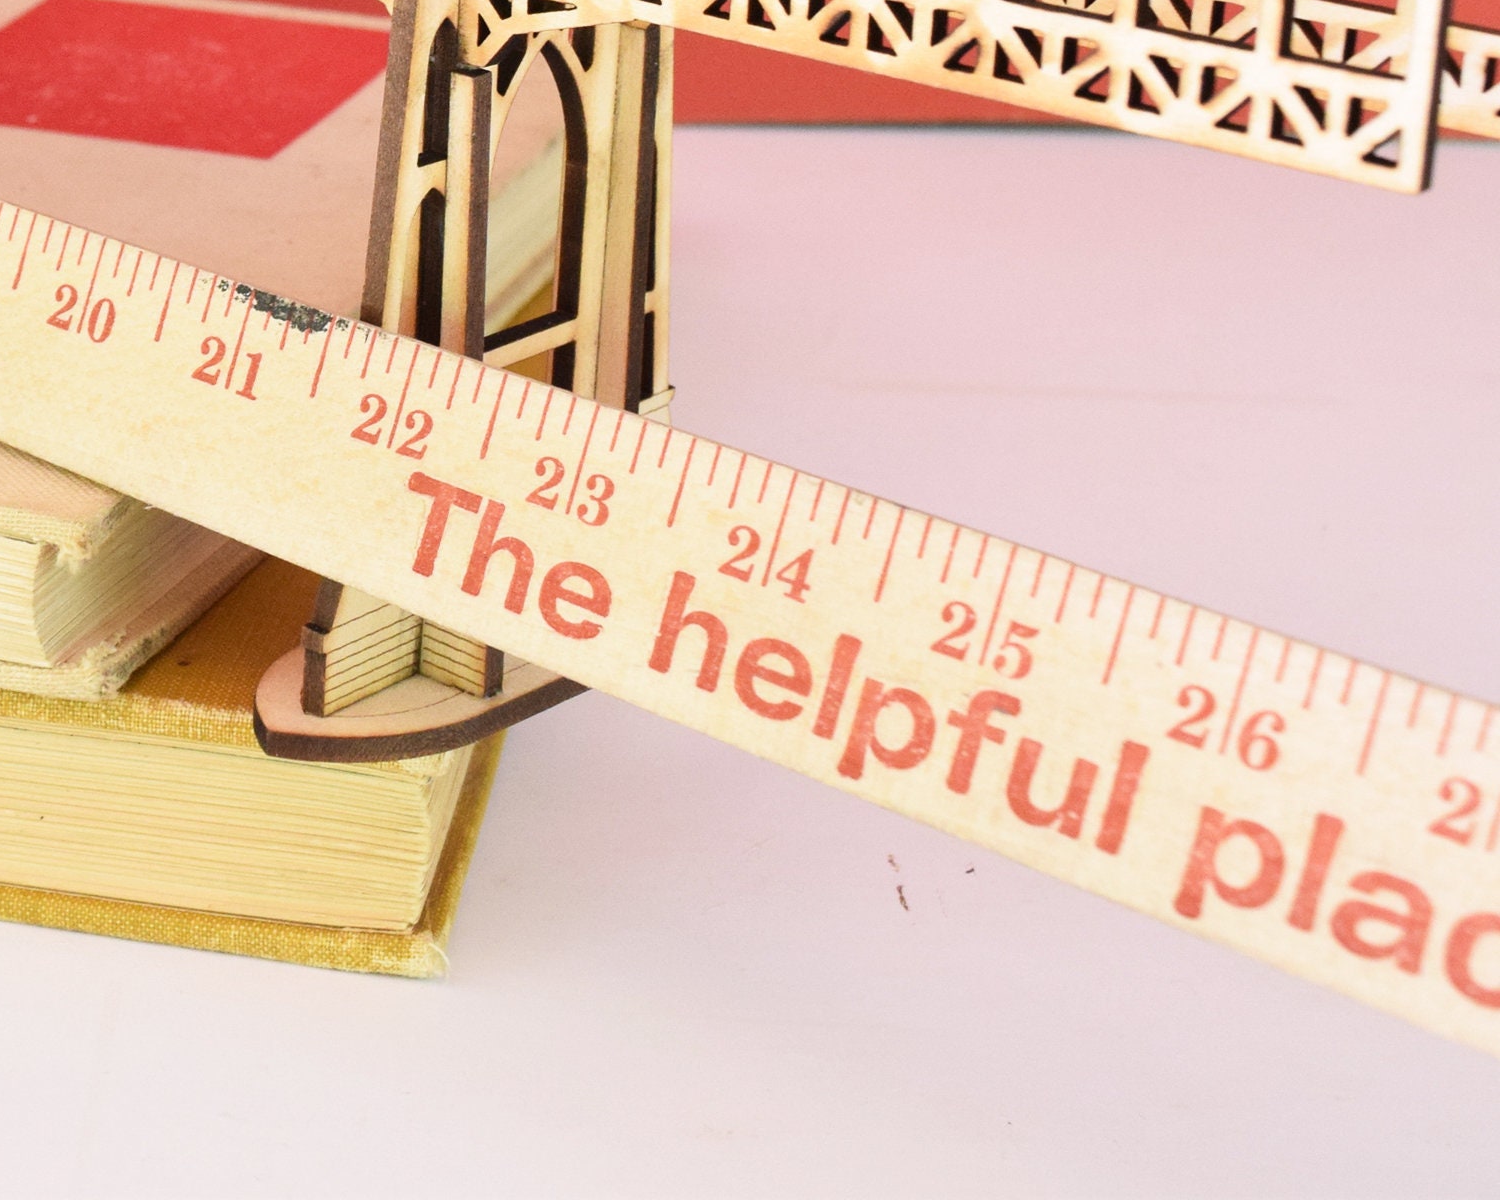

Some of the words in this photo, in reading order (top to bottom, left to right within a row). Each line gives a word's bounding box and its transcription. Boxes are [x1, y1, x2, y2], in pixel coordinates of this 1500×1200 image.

[47, 284, 117, 343] 20
[191, 335, 262, 402] 21
[350, 393, 434, 460] 22
[526, 456, 616, 527] 23
[718, 525, 815, 605] 24
[930, 600, 1040, 680] 25
[1165, 684, 1287, 772] 26
[406, 471, 613, 641] The
[649, 571, 1150, 856] helpful
